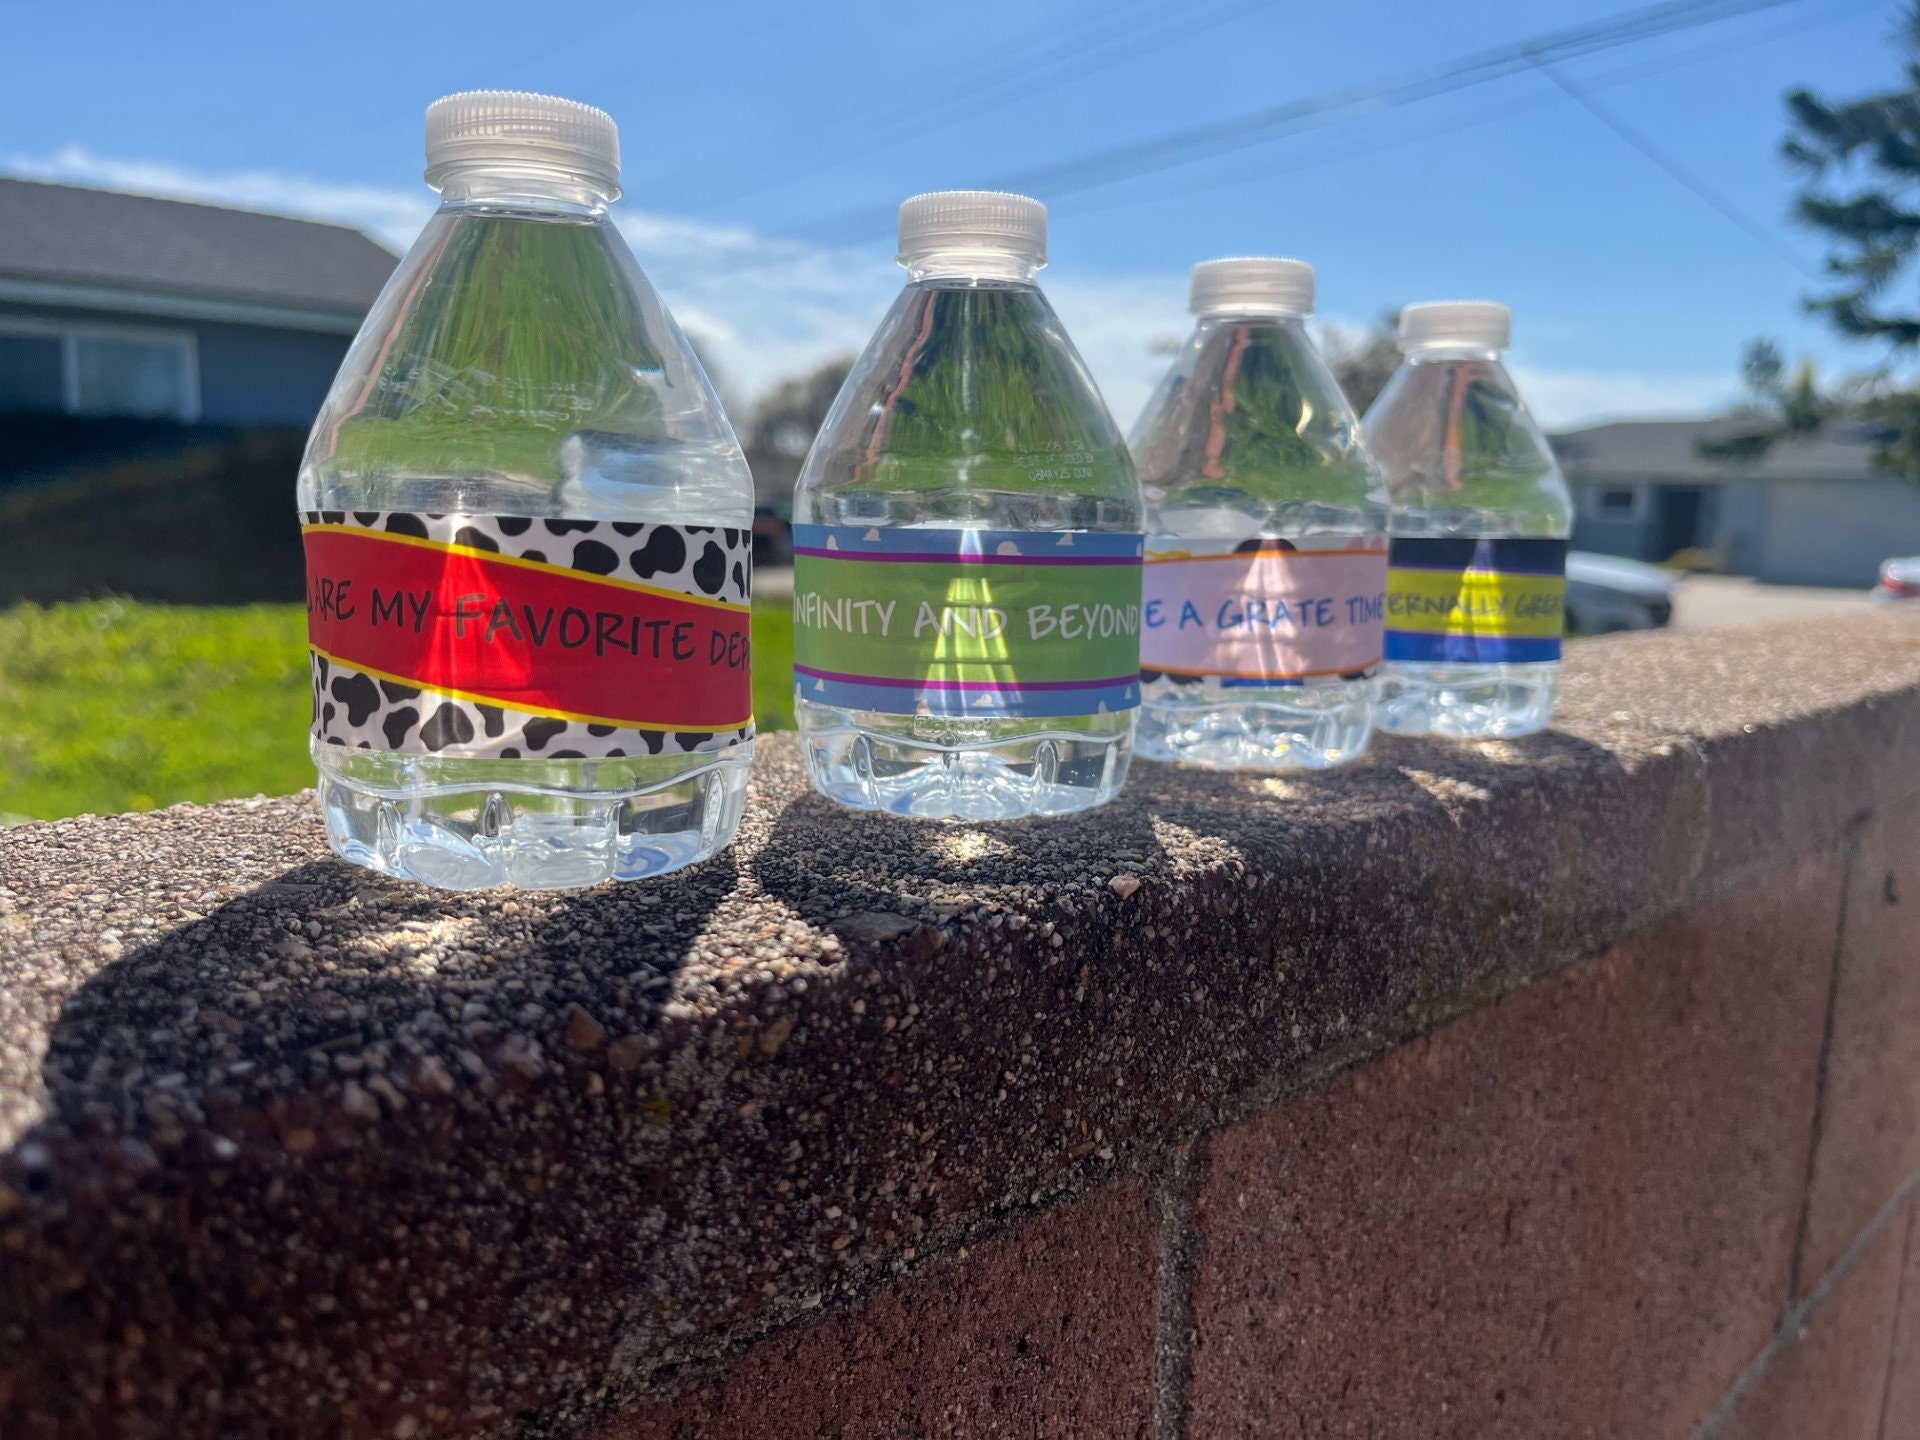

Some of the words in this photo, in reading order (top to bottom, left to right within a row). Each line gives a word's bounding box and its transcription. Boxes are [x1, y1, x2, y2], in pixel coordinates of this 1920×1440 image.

[314, 578, 356, 621] ARE
[371, 587, 432, 633] MY
[455, 593, 697, 660] FAVORITE
[710, 630, 750, 673] DEP
[913, 601, 1008, 639] AND
[1028, 603, 1139, 640] BEYOND
[1179, 599, 1204, 629] A
[1216, 598, 1336, 632] GRATE
